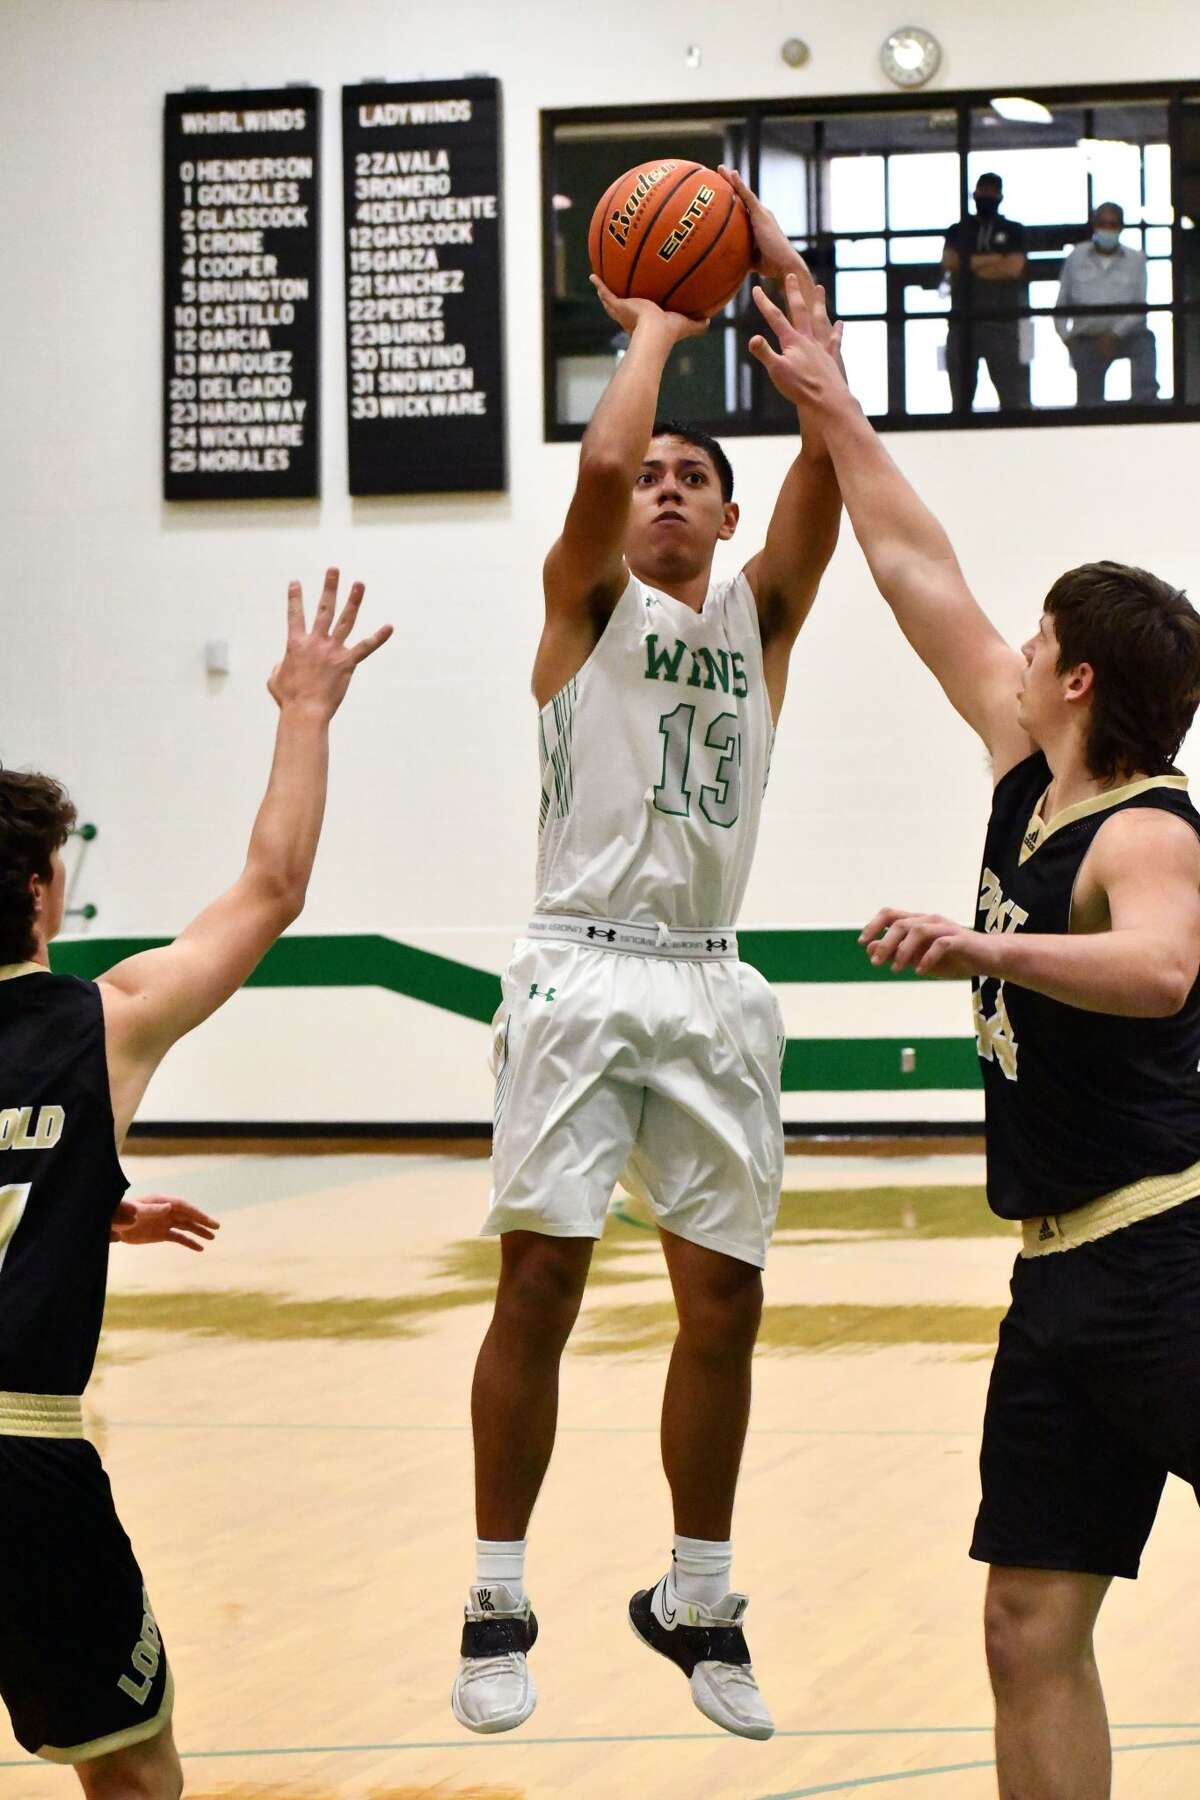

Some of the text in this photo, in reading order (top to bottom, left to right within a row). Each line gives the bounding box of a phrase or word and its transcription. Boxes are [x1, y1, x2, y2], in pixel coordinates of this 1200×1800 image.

[182, 109, 305, 133] WHIRLWINDS
[359, 100, 471, 126] LADYWINDS
[181, 158, 312, 181] 0 HENDERSON
[356, 151, 448, 174] 2 ZAVALA
[185, 183, 298, 205] 1 GONZALES
[356, 175, 449, 198] 3 ROMERO
[181, 207, 307, 229] 2 GLASSCOCK
[357, 203, 369, 222] 4
[657, 185, 715, 262] ELITE
[183, 234, 195, 253] 3
[351, 228, 371, 247] 12
[182, 256, 277, 276] 4 COOPER
[351, 249, 438, 271] 15 GARZA
[183, 282, 195, 301] 5
[351, 271, 463, 295] 21 SANCHEZ
[175, 304, 293, 326] 10 CASTILLO
[350, 297, 443, 320] 22 PEREZ
[175, 329, 270, 349] 12 GARCIA
[200, 352, 292, 373] MARQUEZ
[352, 345, 465, 369] 30 TREVINO
[170, 377, 291, 399] 20 DELGADO
[353, 369, 473, 392] 31 SNOWDEN
[380, 393, 486, 417] WICKWARE
[201, 425, 302, 446] WICKWARE
[201, 450, 288, 470] MORALES
[653, 703, 741, 829] 13
